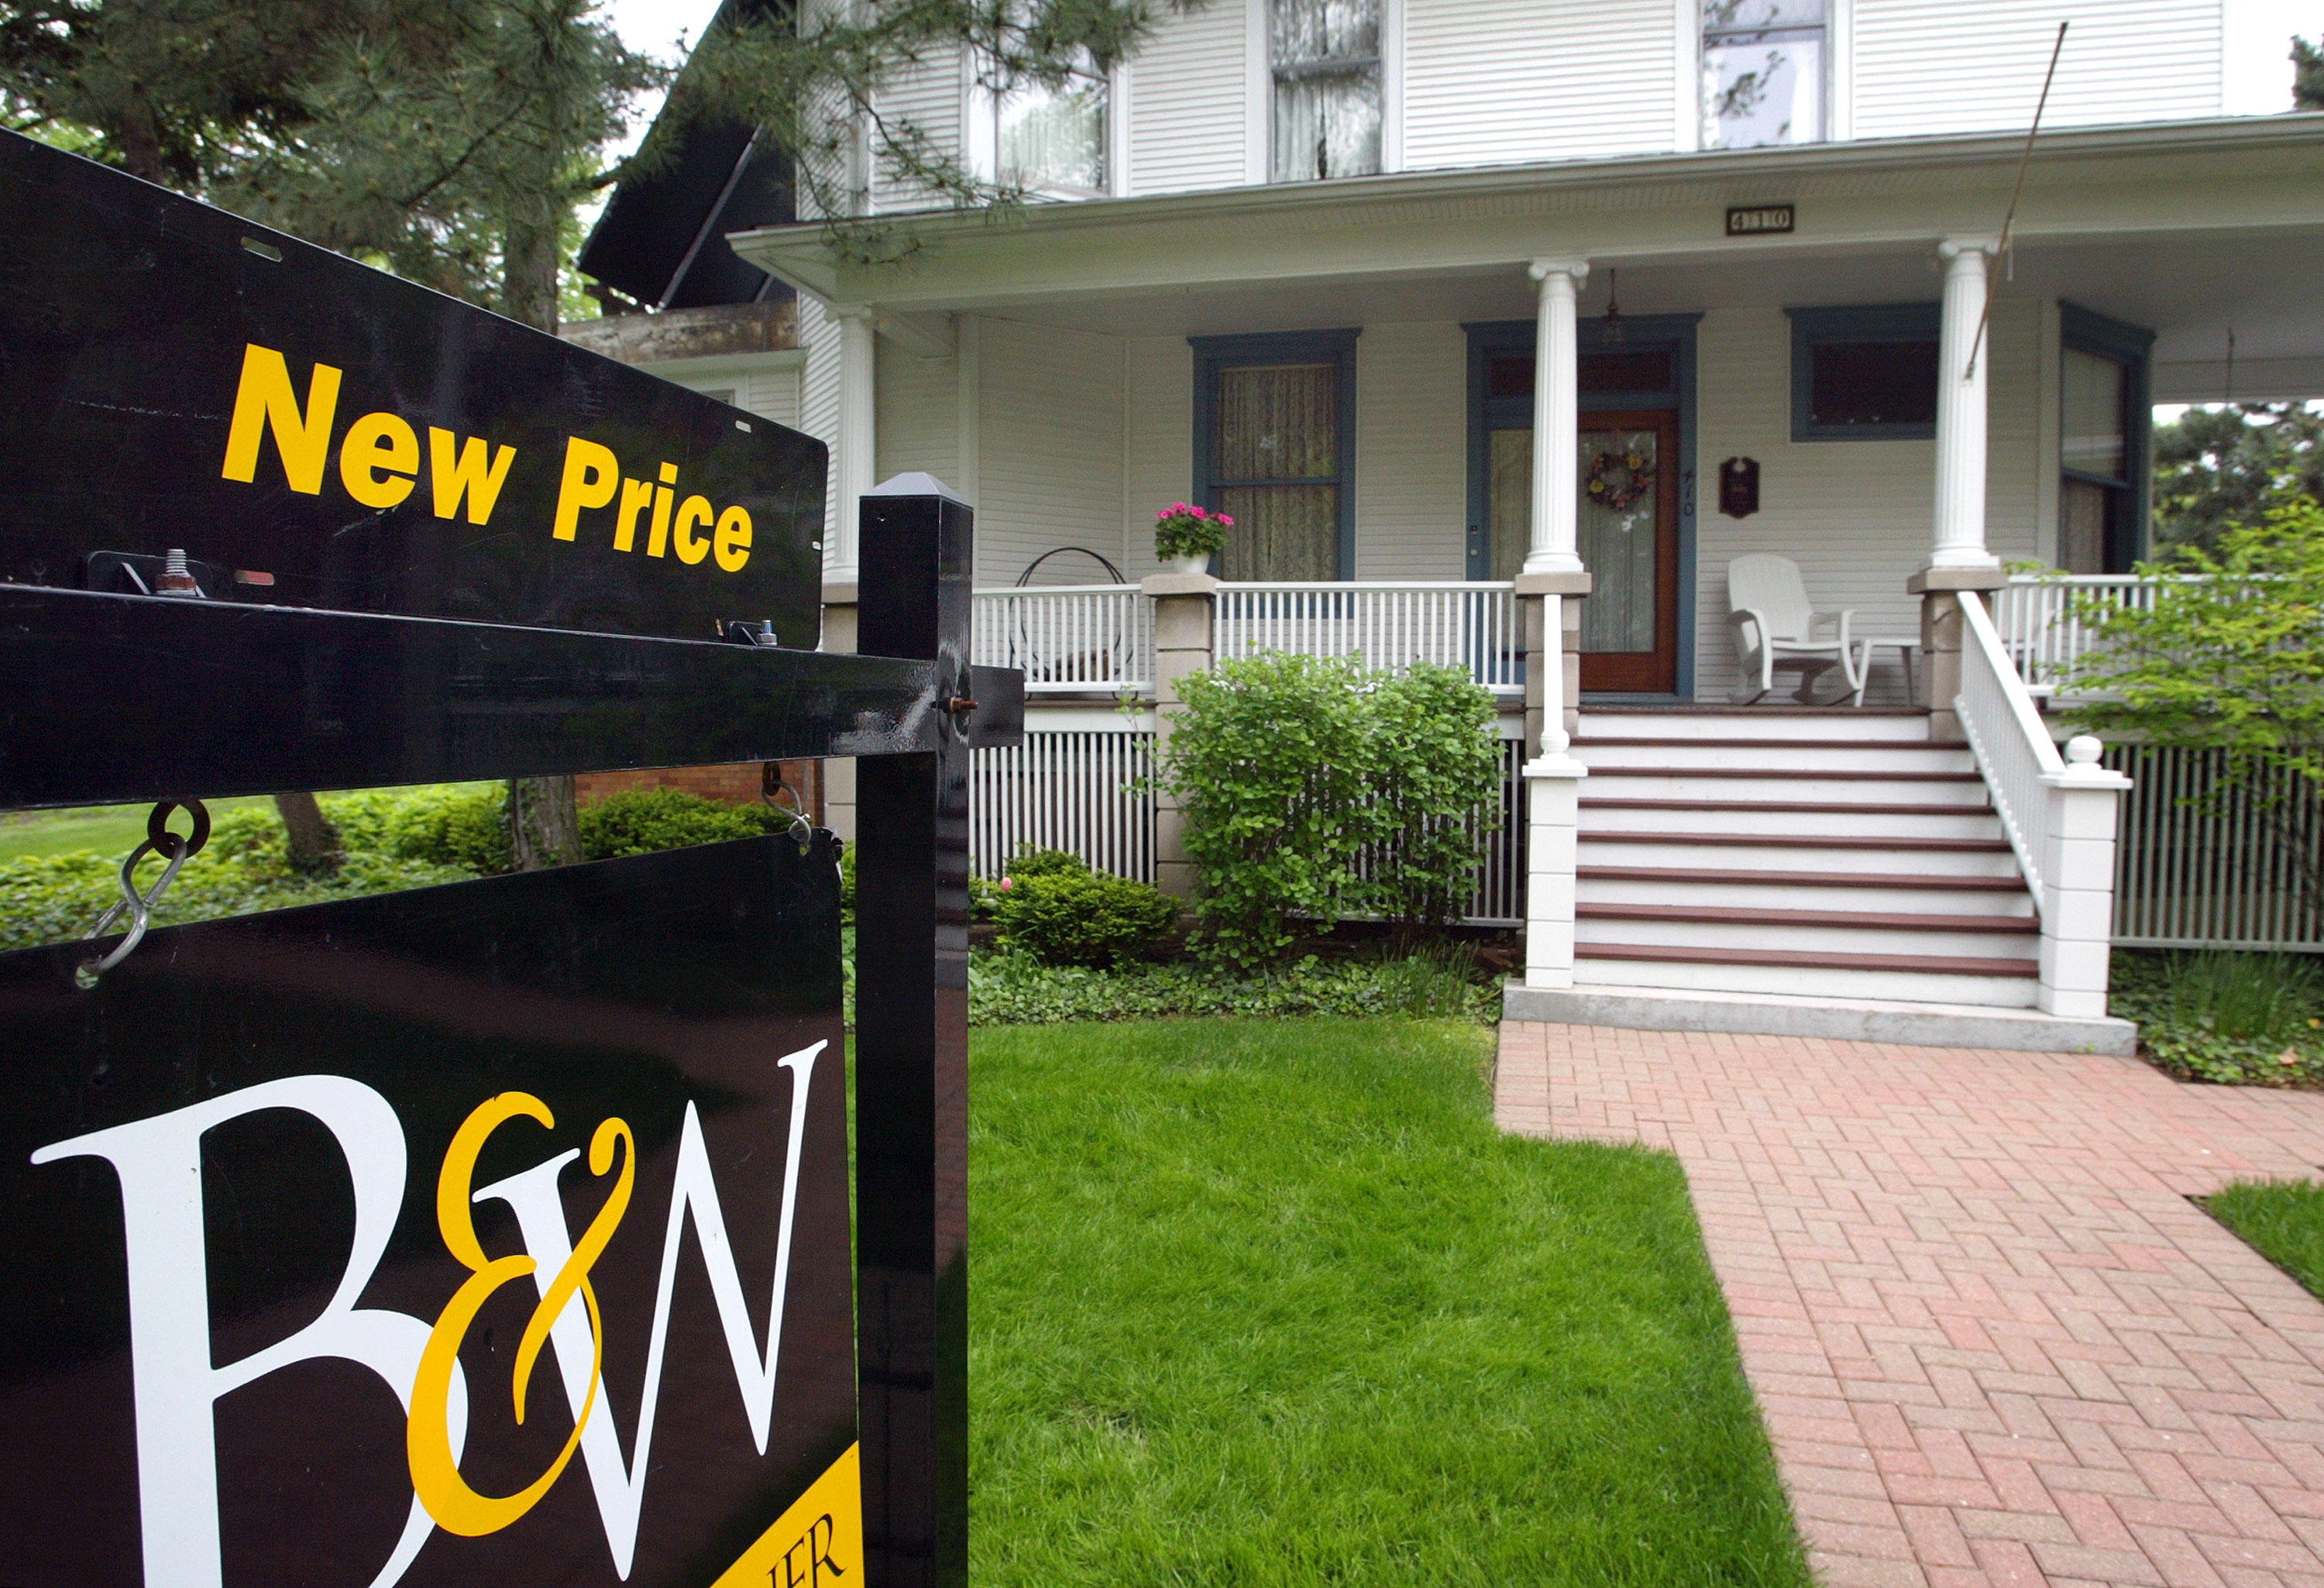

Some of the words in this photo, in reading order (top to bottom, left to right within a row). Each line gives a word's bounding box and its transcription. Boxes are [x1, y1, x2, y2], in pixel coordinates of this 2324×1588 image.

[222, 343, 517, 526] New
[552, 435, 753, 572] Price
[31, 1039, 828, 1588] B&W
